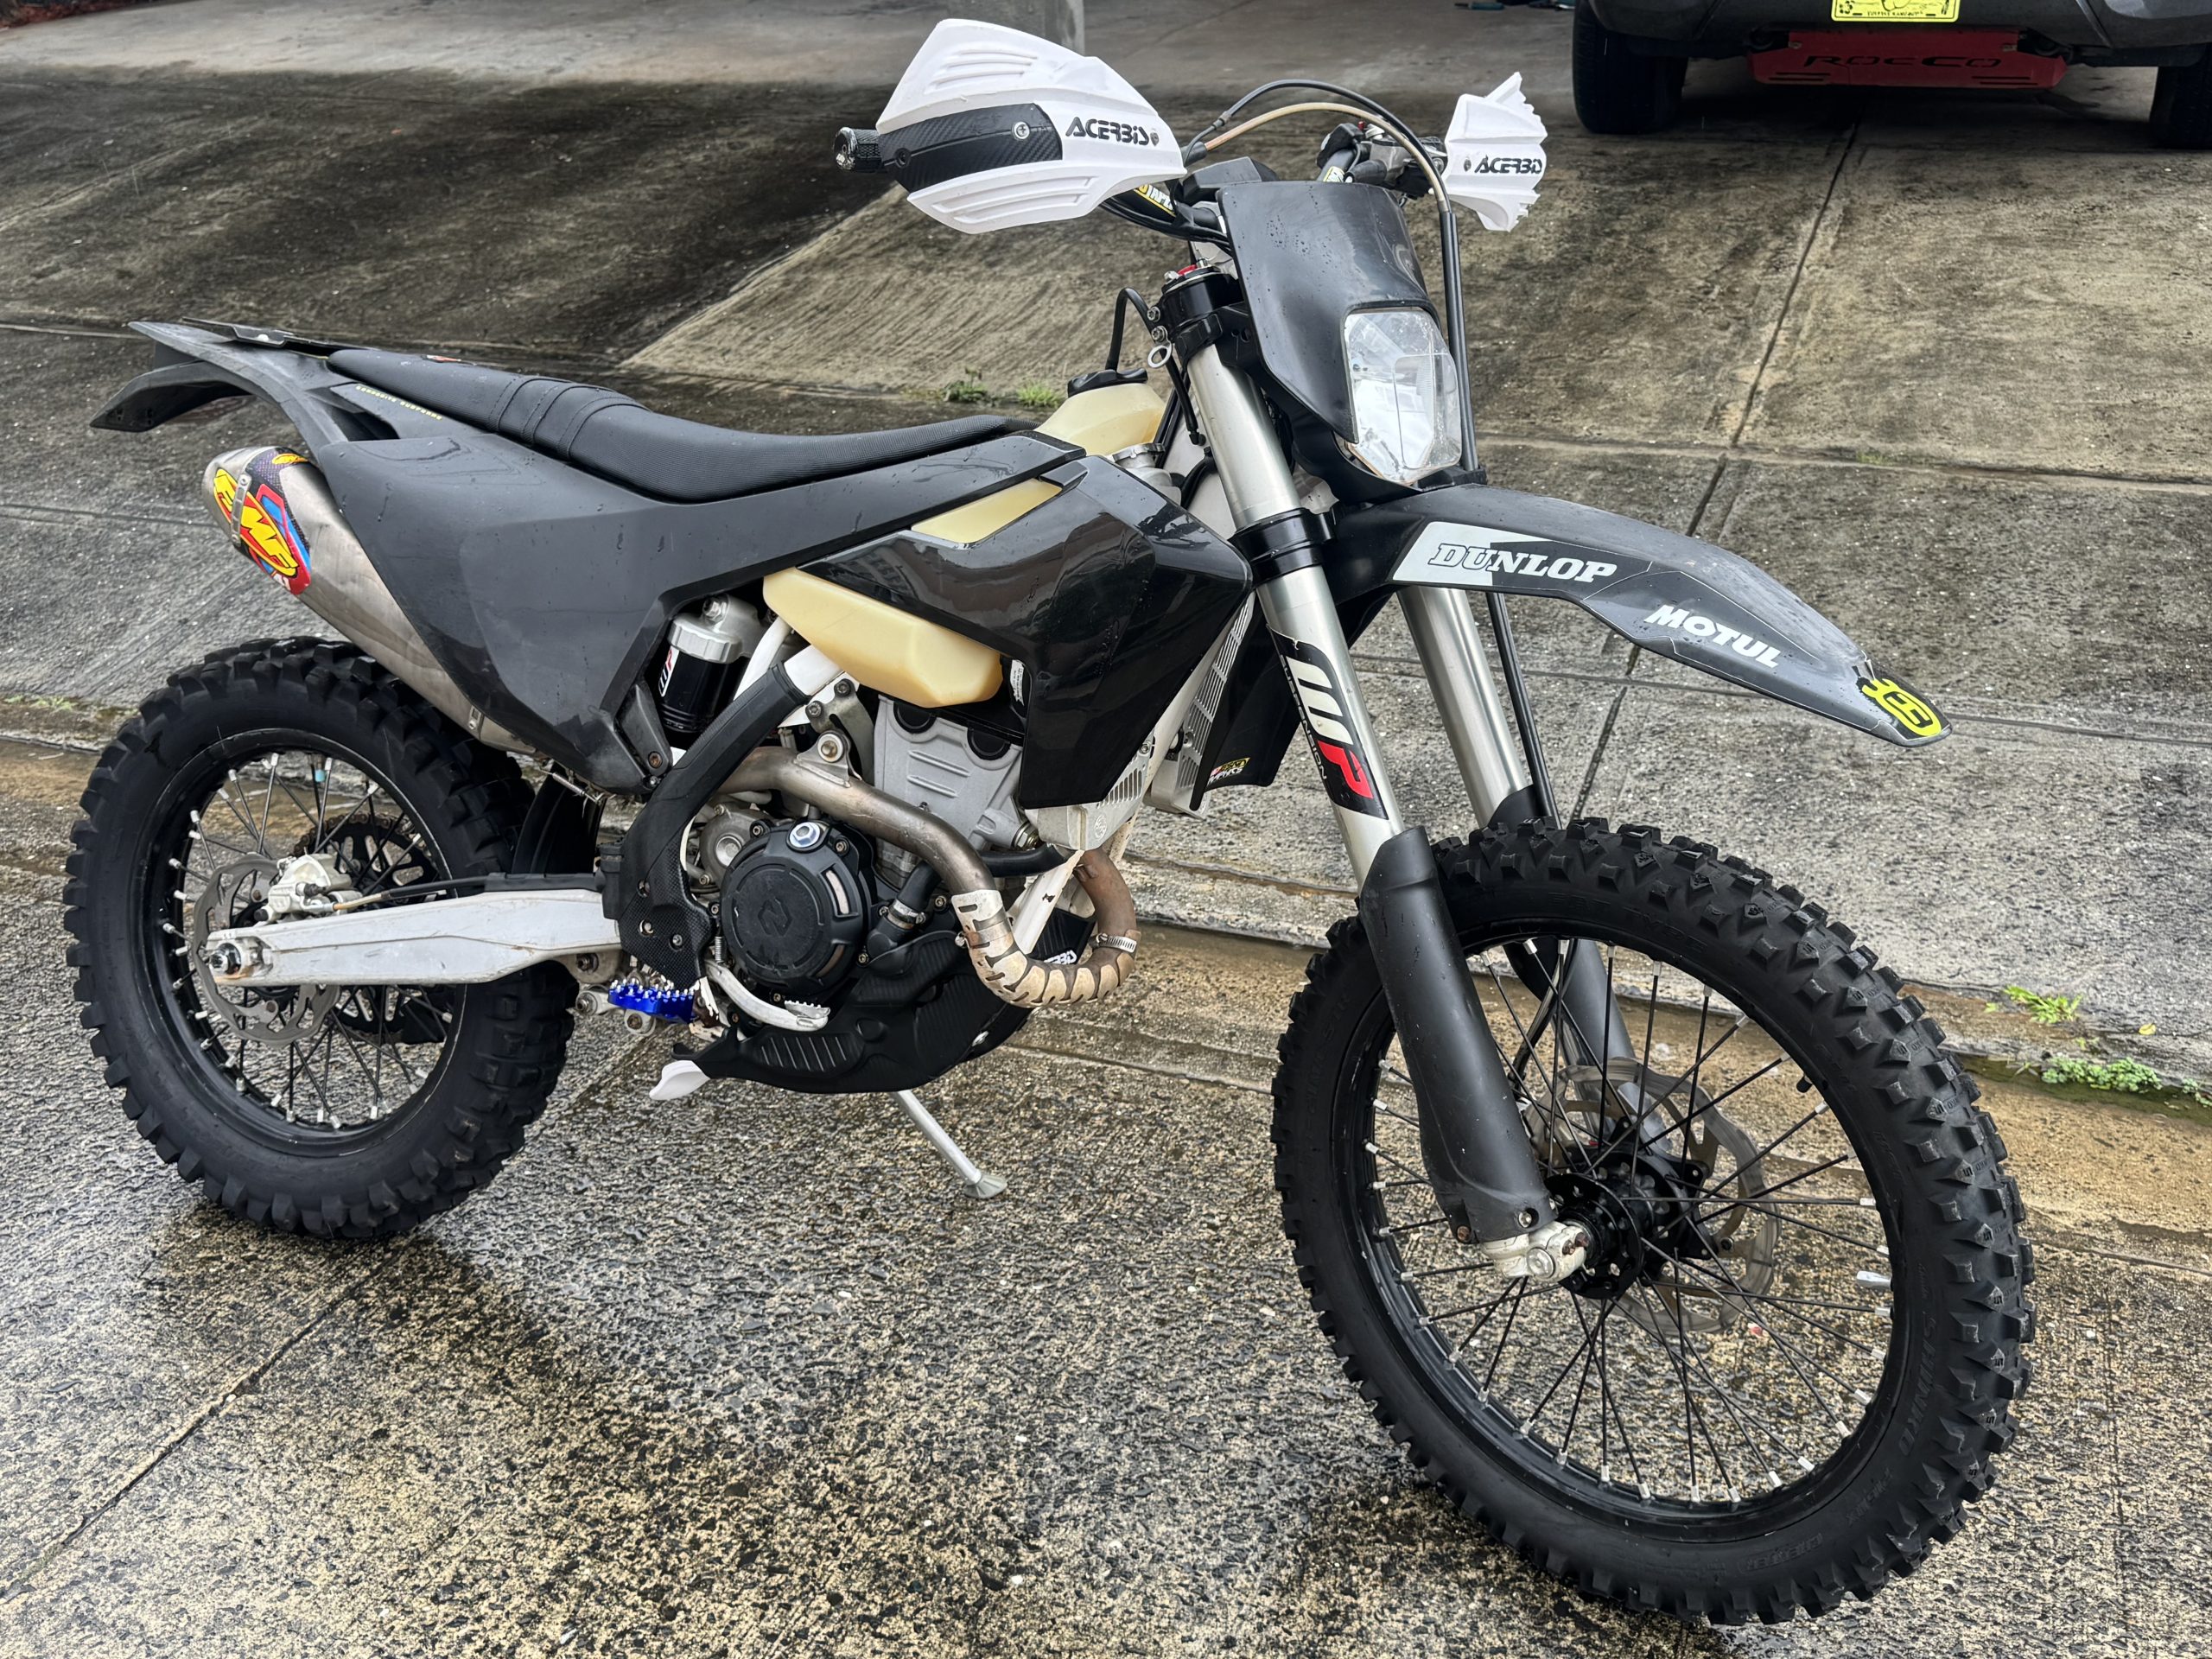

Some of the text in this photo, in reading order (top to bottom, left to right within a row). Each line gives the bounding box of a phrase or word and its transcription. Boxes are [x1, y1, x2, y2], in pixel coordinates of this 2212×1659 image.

[1803, 55, 2002, 68] ROCCO
[1065, 116, 1150, 146] ACERBIS
[1427, 543, 1618, 583] DUNLOP
[1643, 605, 1782, 669] MOTUL
[1279, 653, 1328, 781] SUSPENSION
[1898, 1310, 1938, 1458] SHINKO
